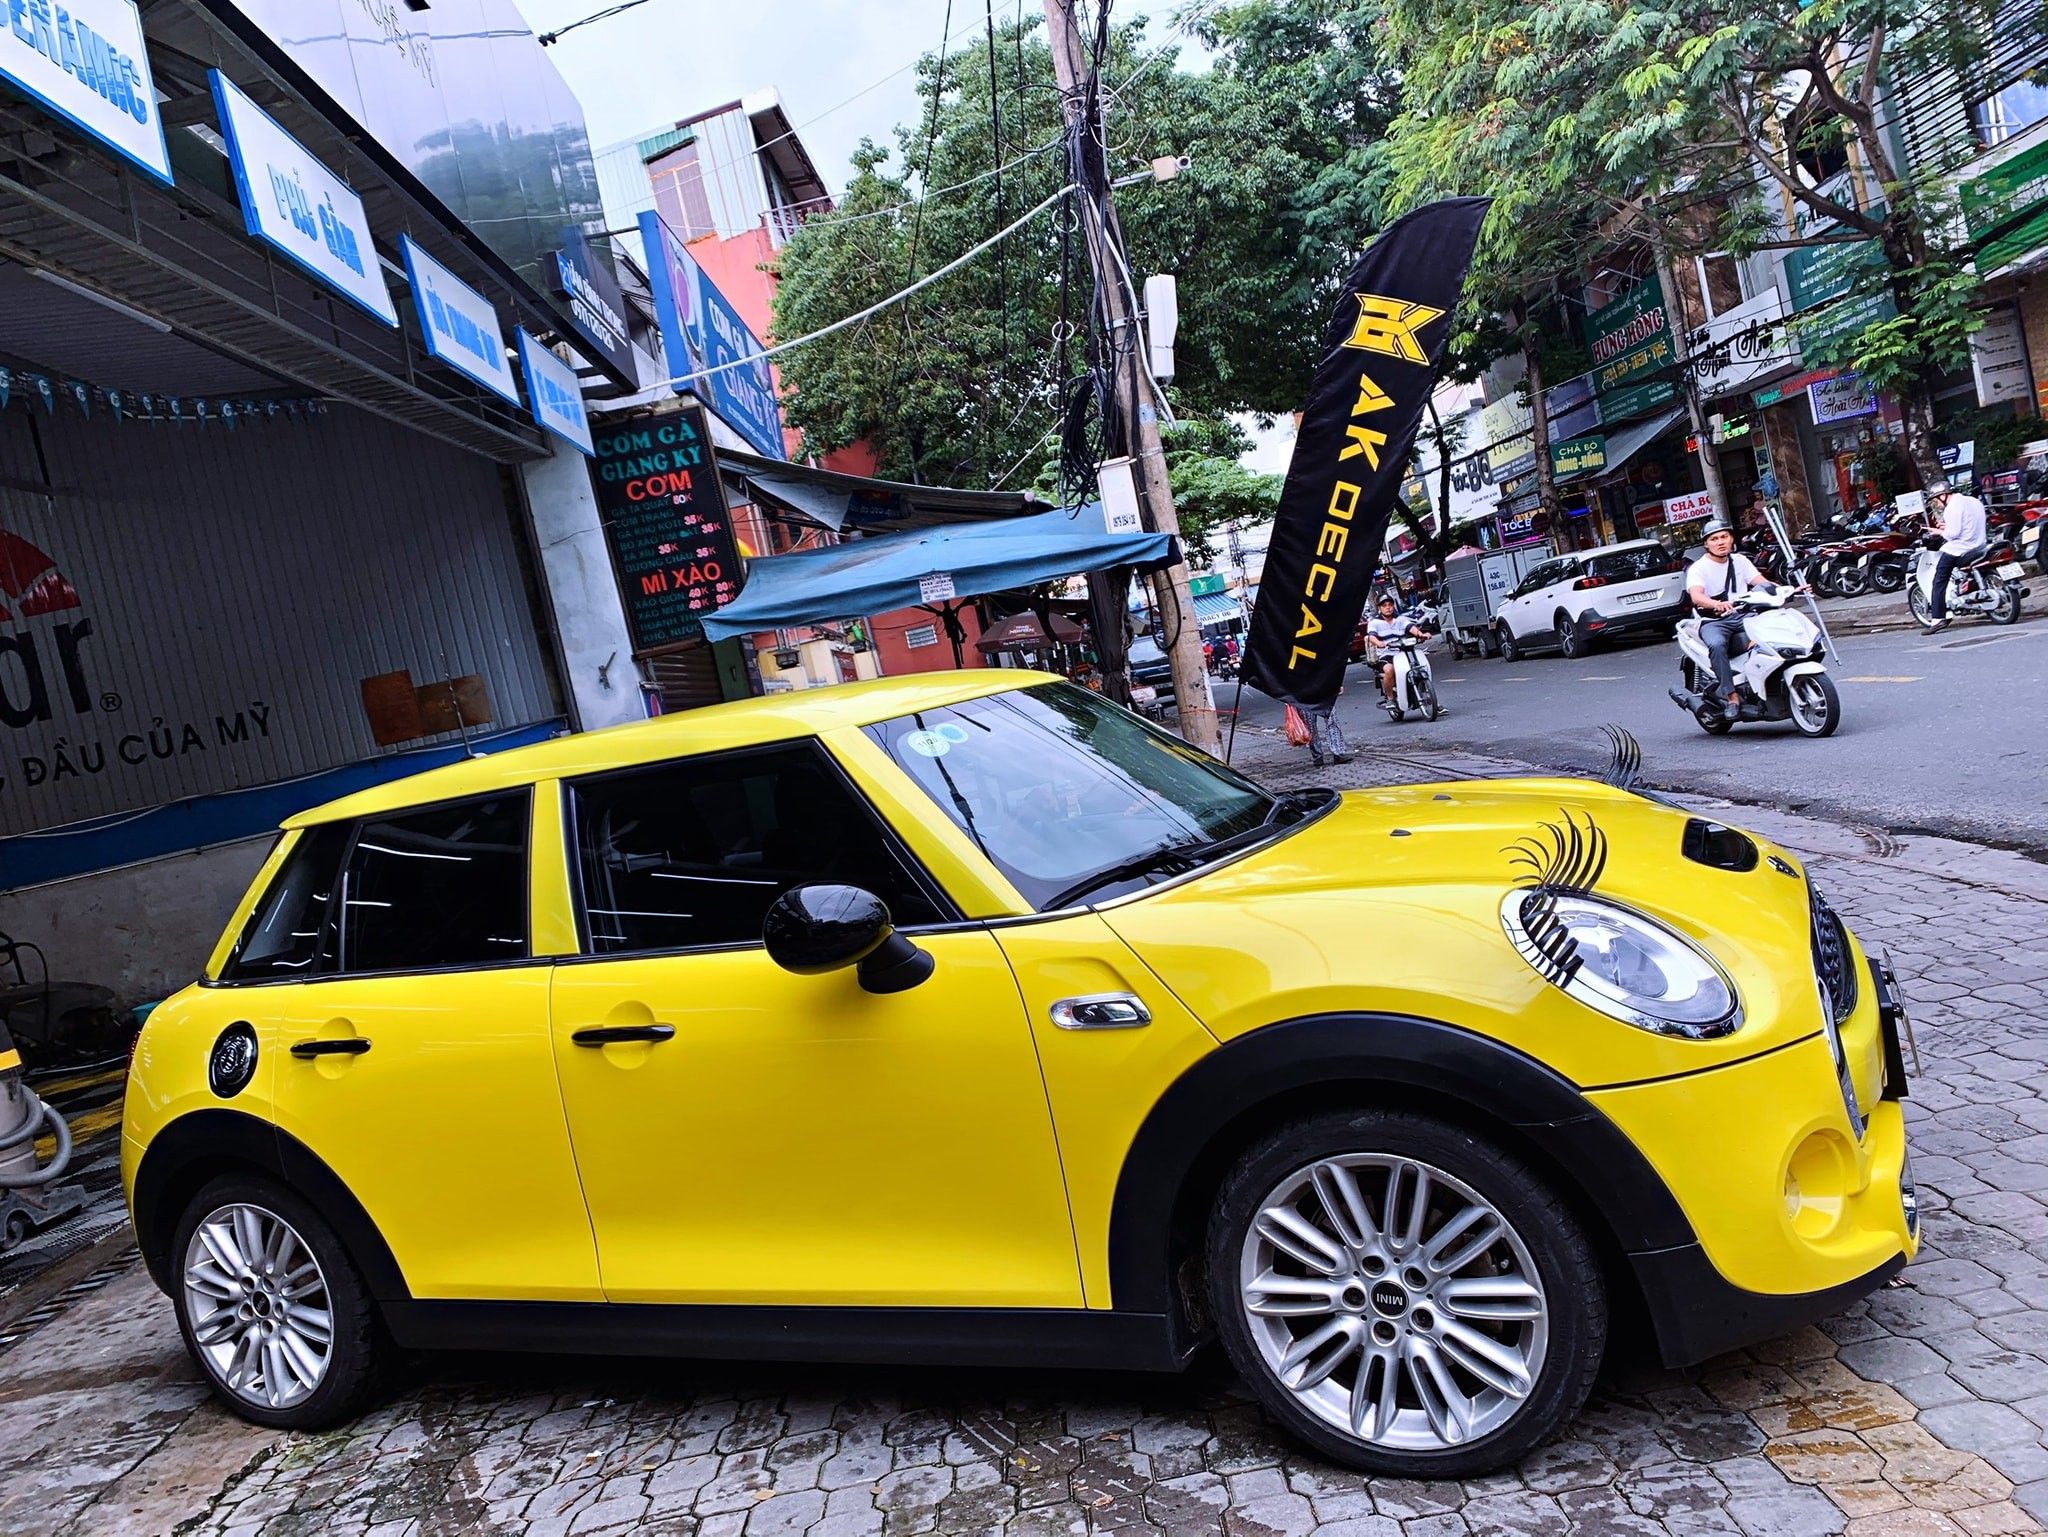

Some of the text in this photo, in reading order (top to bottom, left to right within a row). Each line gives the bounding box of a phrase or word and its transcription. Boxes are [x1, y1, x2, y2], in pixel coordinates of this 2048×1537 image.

[0, 0, 147, 125] ERAMIC
[717, 344, 766, 428] GIANG
[597, 430, 651, 457] CƠM
[657, 417, 697, 445] GÀ
[1558, 440, 1598, 456] CHẢ BÒ
[601, 452, 670, 482] GIANG
[625, 469, 693, 501] CƠM
[1670, 495, 1696, 512] CHẢ
[1288, 373, 1396, 671] AK DECAL
[641, 562, 721, 595] MÌ XÀO
[21, 701, 271, 787] ĐẦU CỦA MỸ
[1376, 1292, 1404, 1306] MINI
